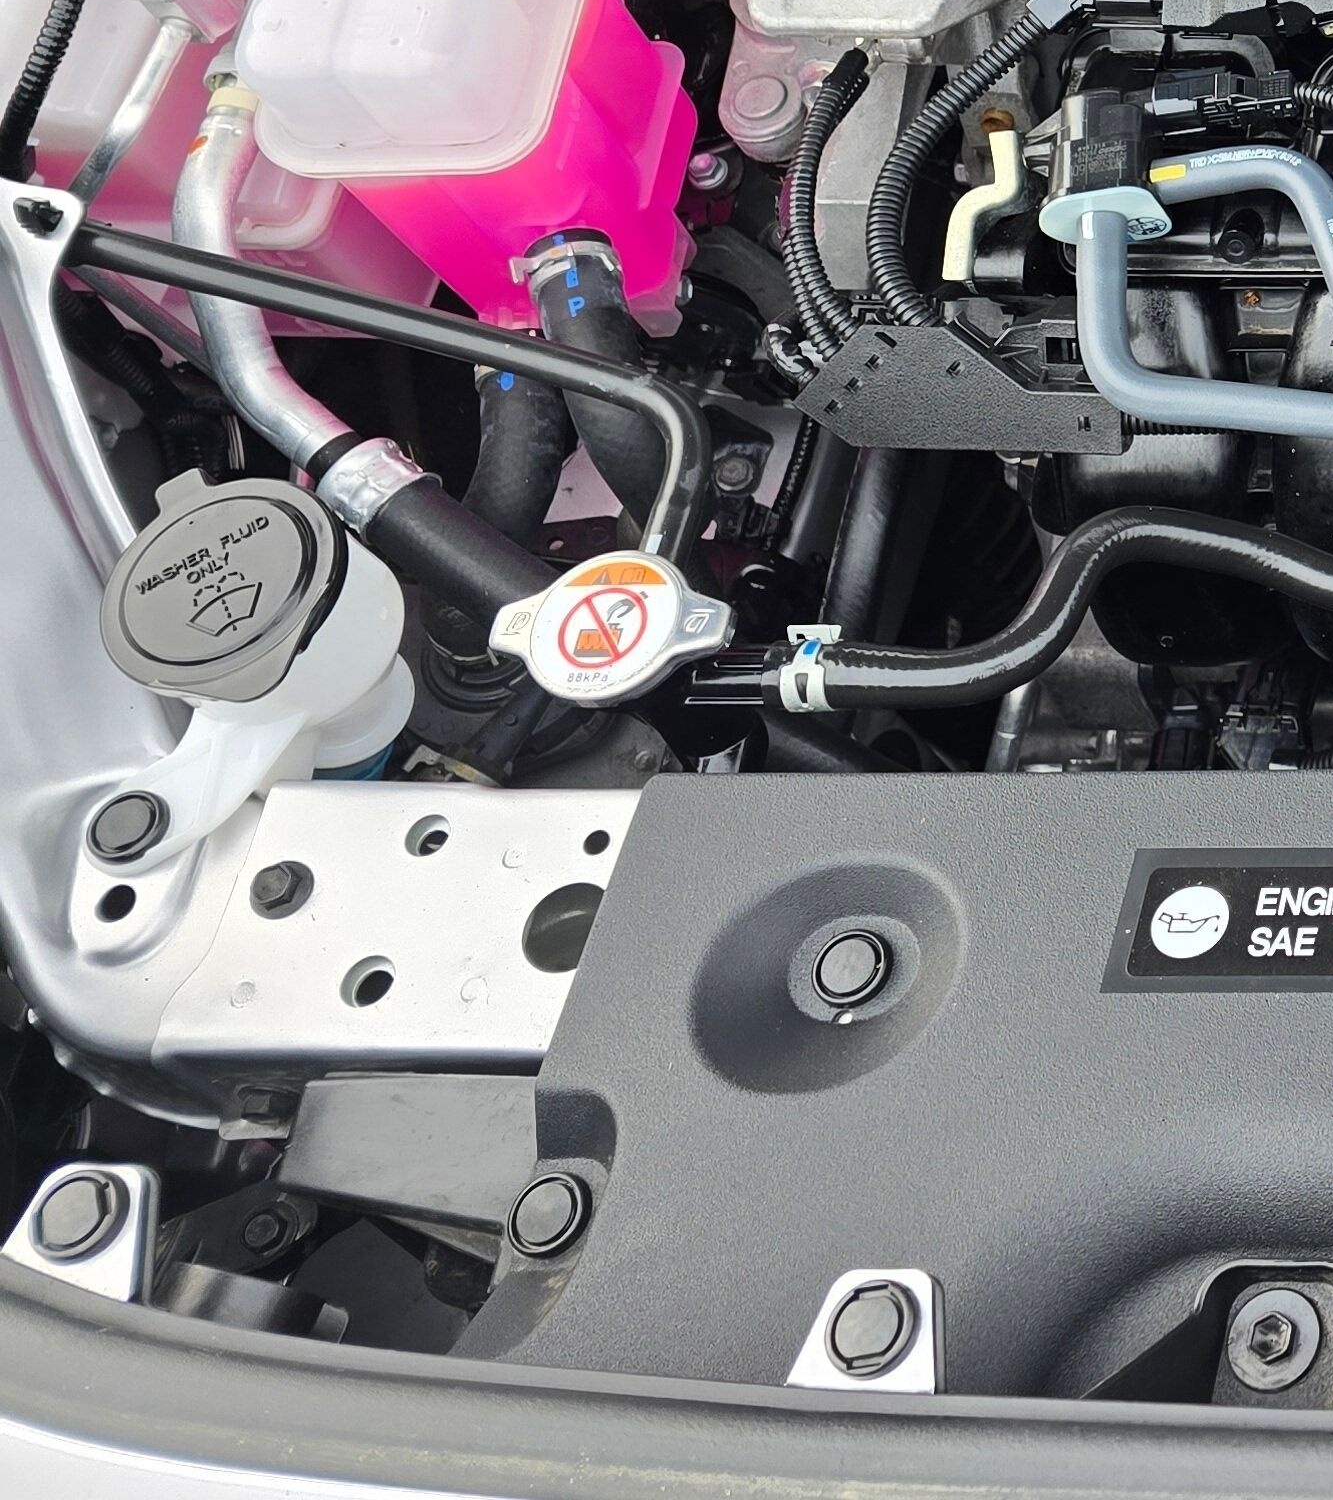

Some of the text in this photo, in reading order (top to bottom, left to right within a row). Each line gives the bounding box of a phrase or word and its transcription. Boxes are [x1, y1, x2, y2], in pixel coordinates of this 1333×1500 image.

[1189, 157, 1207, 169] TRD
[567, 296, 586, 318] P
[134, 515, 270, 595] WASHER FLUID
[185, 551, 230, 584] ONLY
[566, 671, 609, 683] 88kPa
[1246, 926, 1320, 957] SAE
